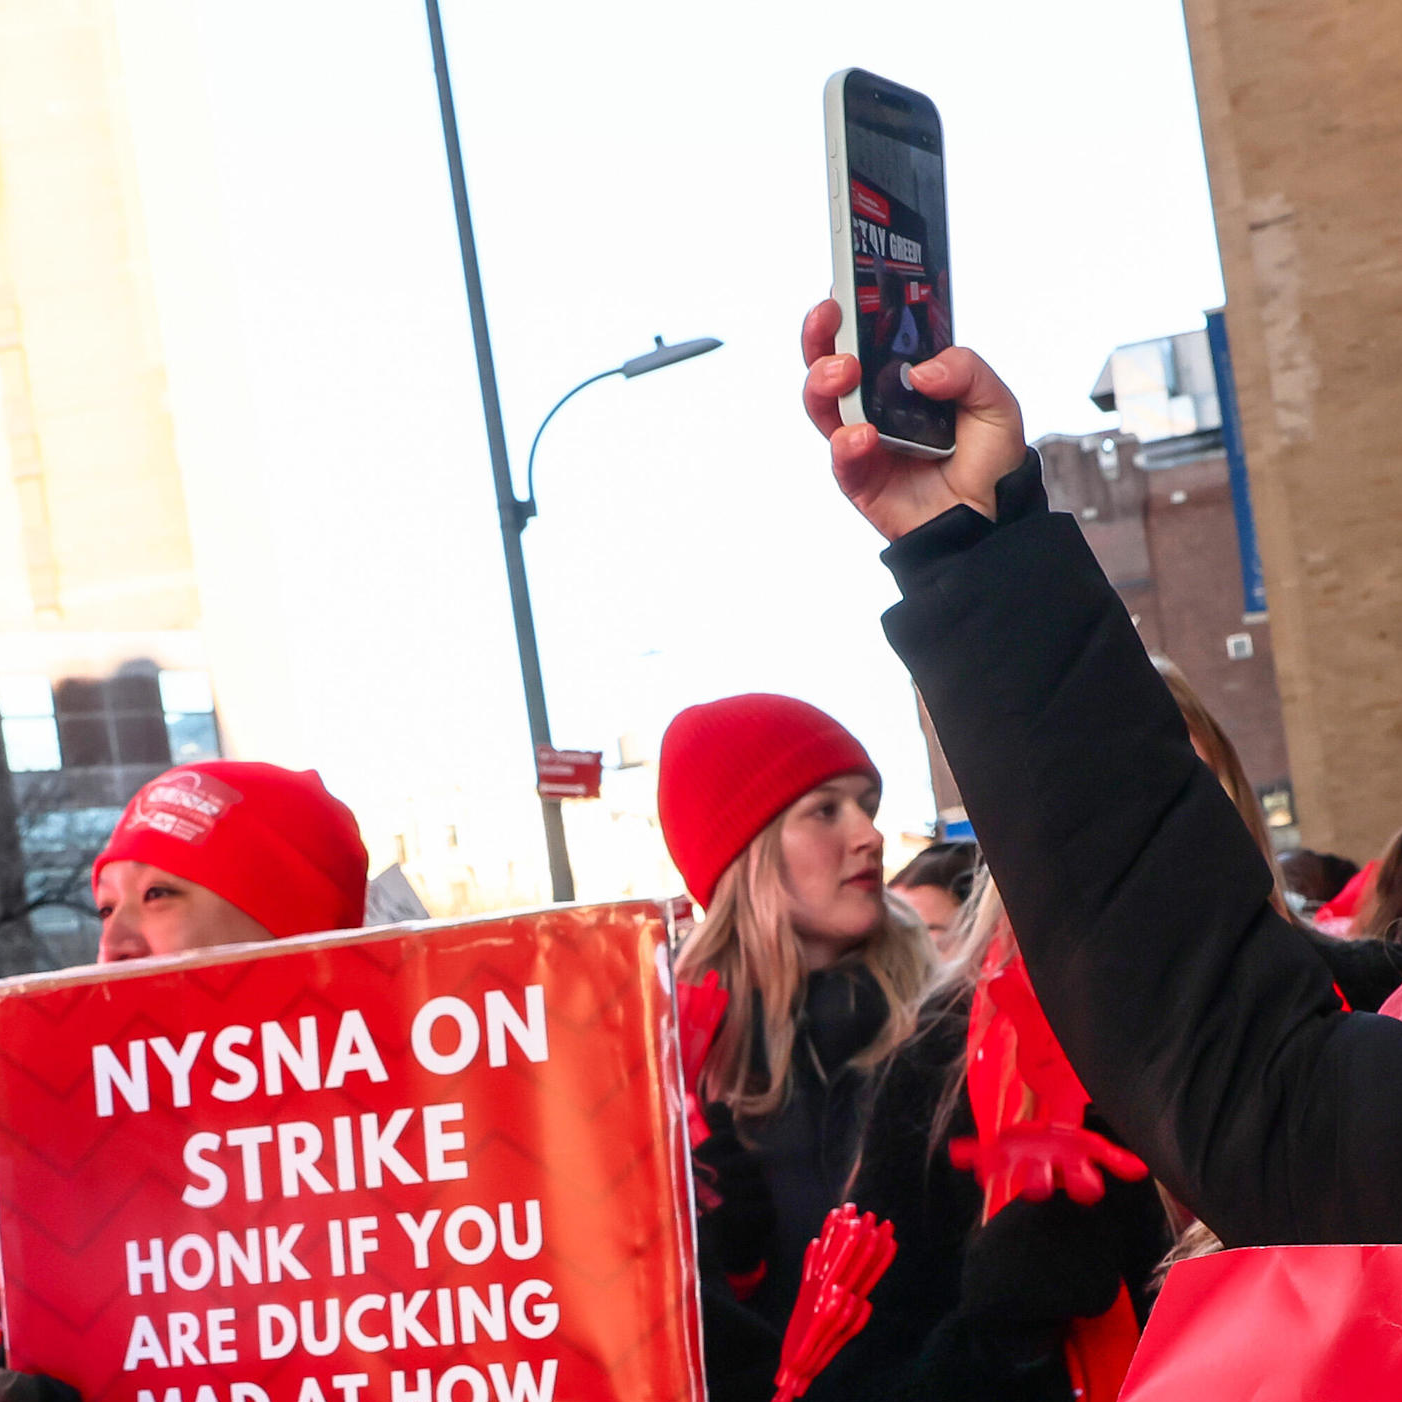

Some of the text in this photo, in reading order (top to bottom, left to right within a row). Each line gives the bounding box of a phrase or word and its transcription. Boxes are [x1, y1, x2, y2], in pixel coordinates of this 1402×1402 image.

[91, 984, 550, 1118] NYSNA ON
[181, 1101, 470, 1209] STRIKE
[124, 1199, 544, 1297] HONK IF YOU
[123, 1279, 561, 1372] ARE DUCKING
